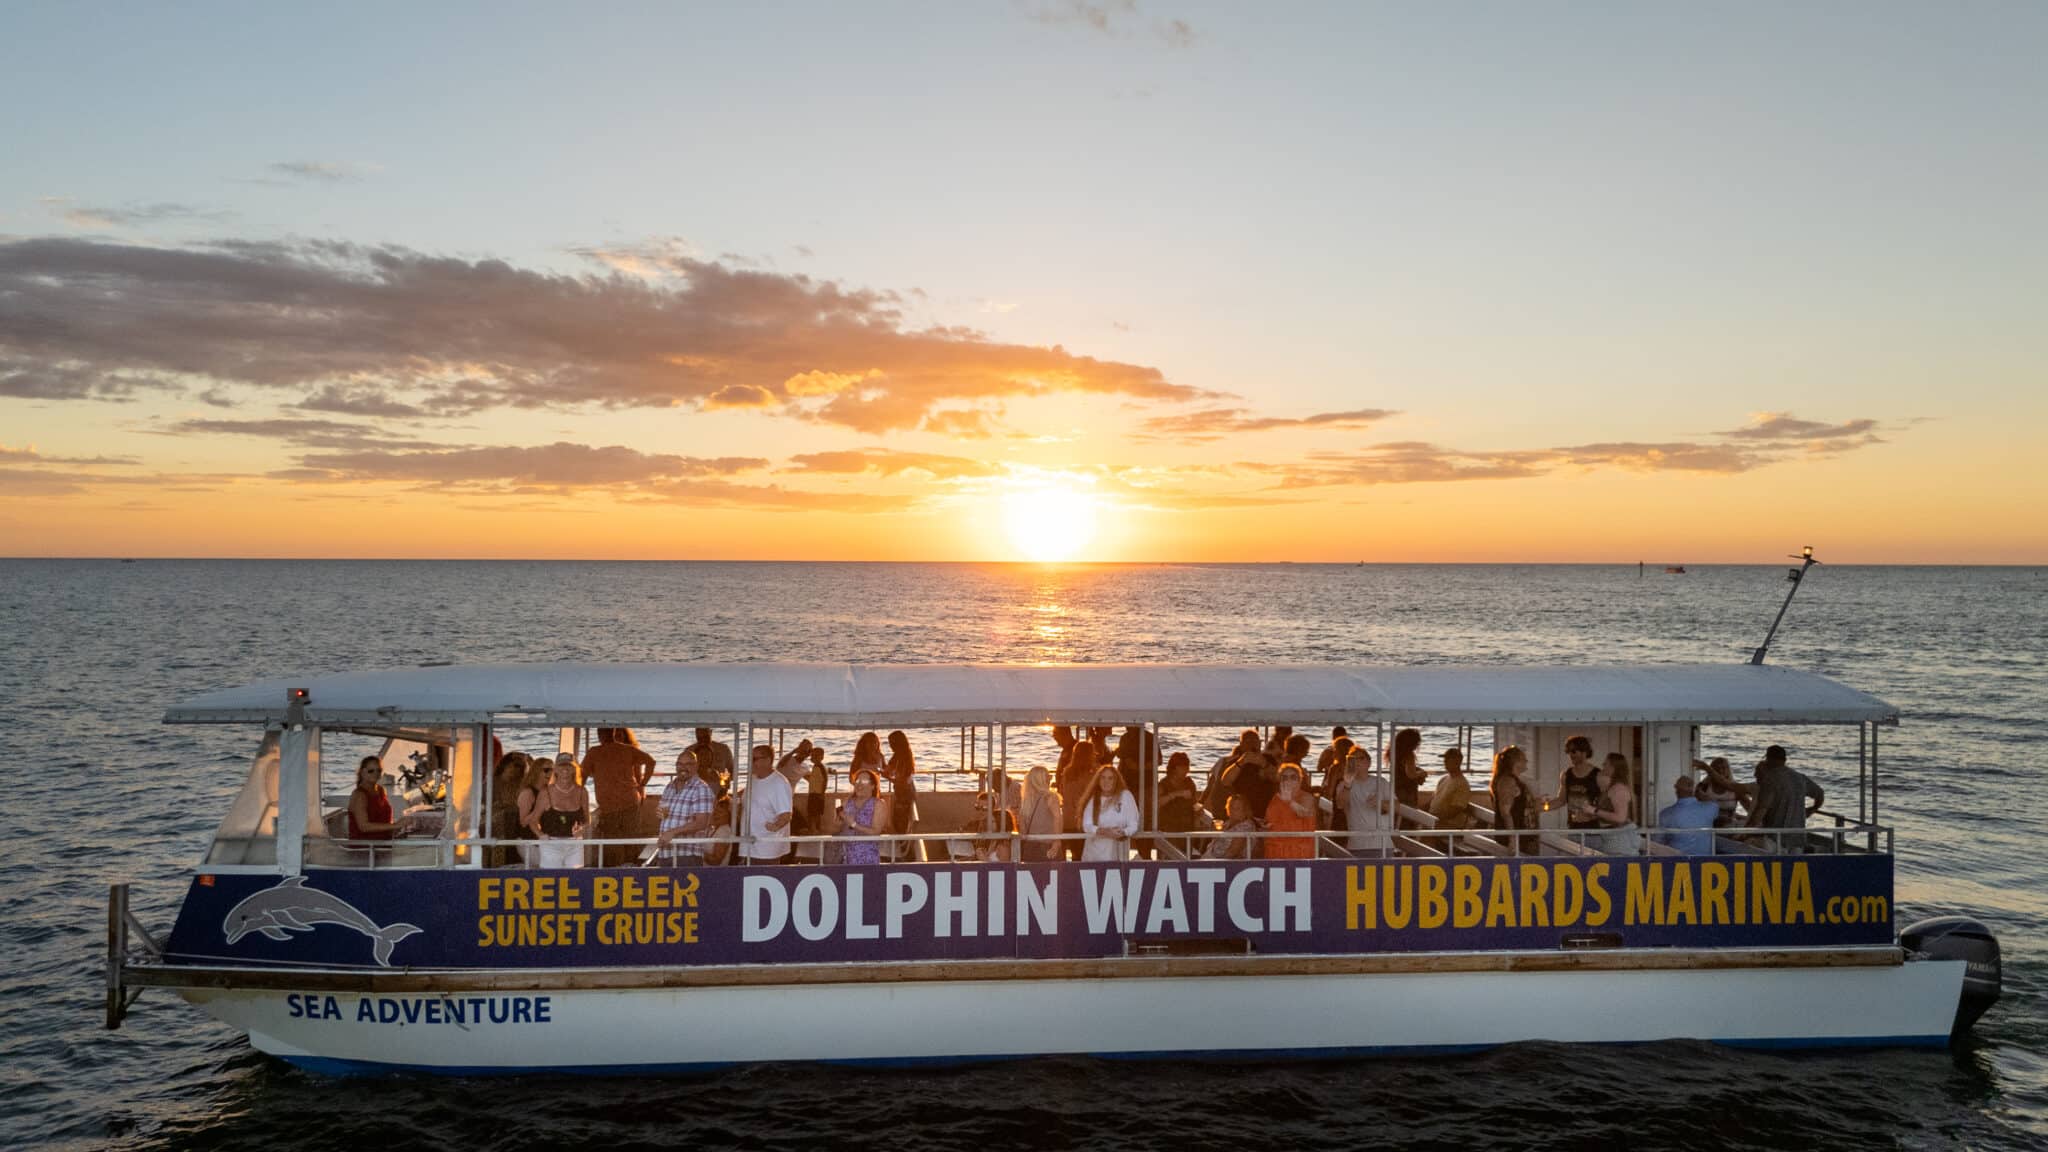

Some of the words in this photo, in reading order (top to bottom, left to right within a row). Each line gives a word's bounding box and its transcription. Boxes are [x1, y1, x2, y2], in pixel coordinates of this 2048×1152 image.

[479, 877, 581, 910] FREE
[594, 873, 700, 909] BEER
[743, 870, 1057, 941] DOLPHIN
[1080, 868, 1311, 933] WATCH
[1345, 862, 1612, 930] HUBBARDS
[1625, 862, 1887, 925] MARINA.com
[478, 913, 590, 946] SUNSET
[597, 912, 699, 944] CRUISE
[287, 993, 342, 1020] SEA
[357, 997, 551, 1024] ADVENTURE
